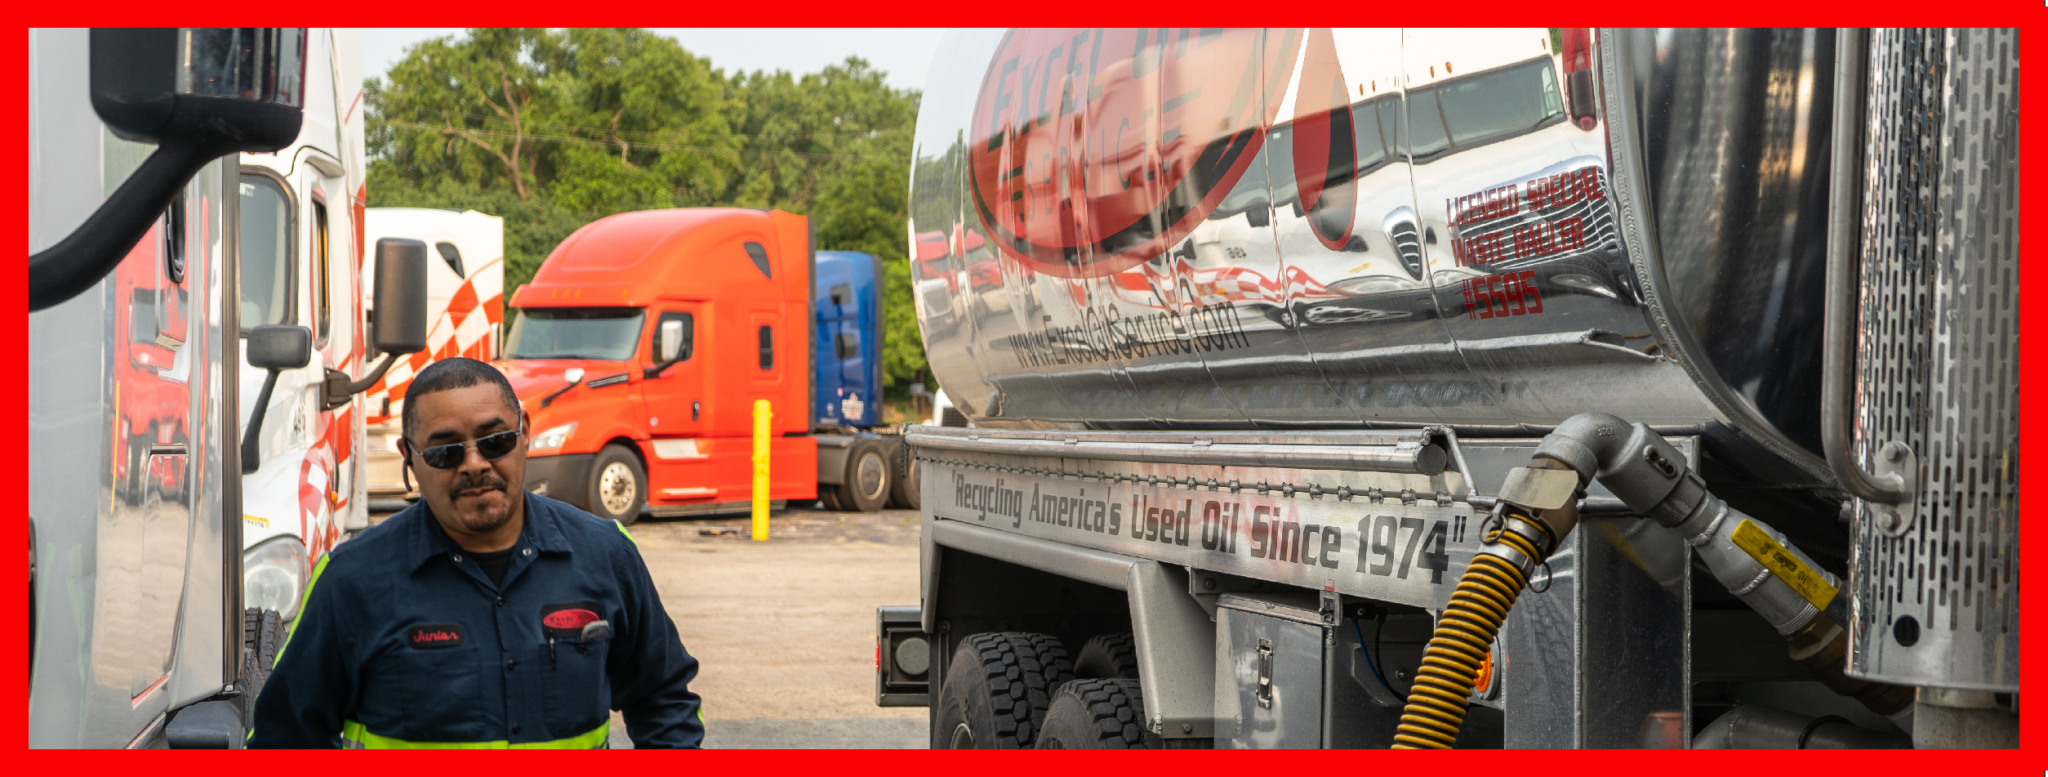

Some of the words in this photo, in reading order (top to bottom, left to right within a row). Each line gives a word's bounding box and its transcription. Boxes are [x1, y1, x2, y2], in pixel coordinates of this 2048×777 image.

[987, 28, 1105, 154] EXCEL
[1446, 183, 1520, 227] LICENSED
[1527, 166, 1605, 212] SPECIAL
[1451, 231, 1507, 267] WASTE
[1512, 216, 1586, 259] HAULER
[1462, 269, 1544, 320] #5595
[952, 469, 1024, 528] "Recycling
[1029, 483, 1122, 536] America's
[1131, 493, 1192, 547] Used
[1201, 500, 1240, 555] Oil
[1251, 505, 1342, 569] Since
[1356, 514, 1468, 585] 1974"
